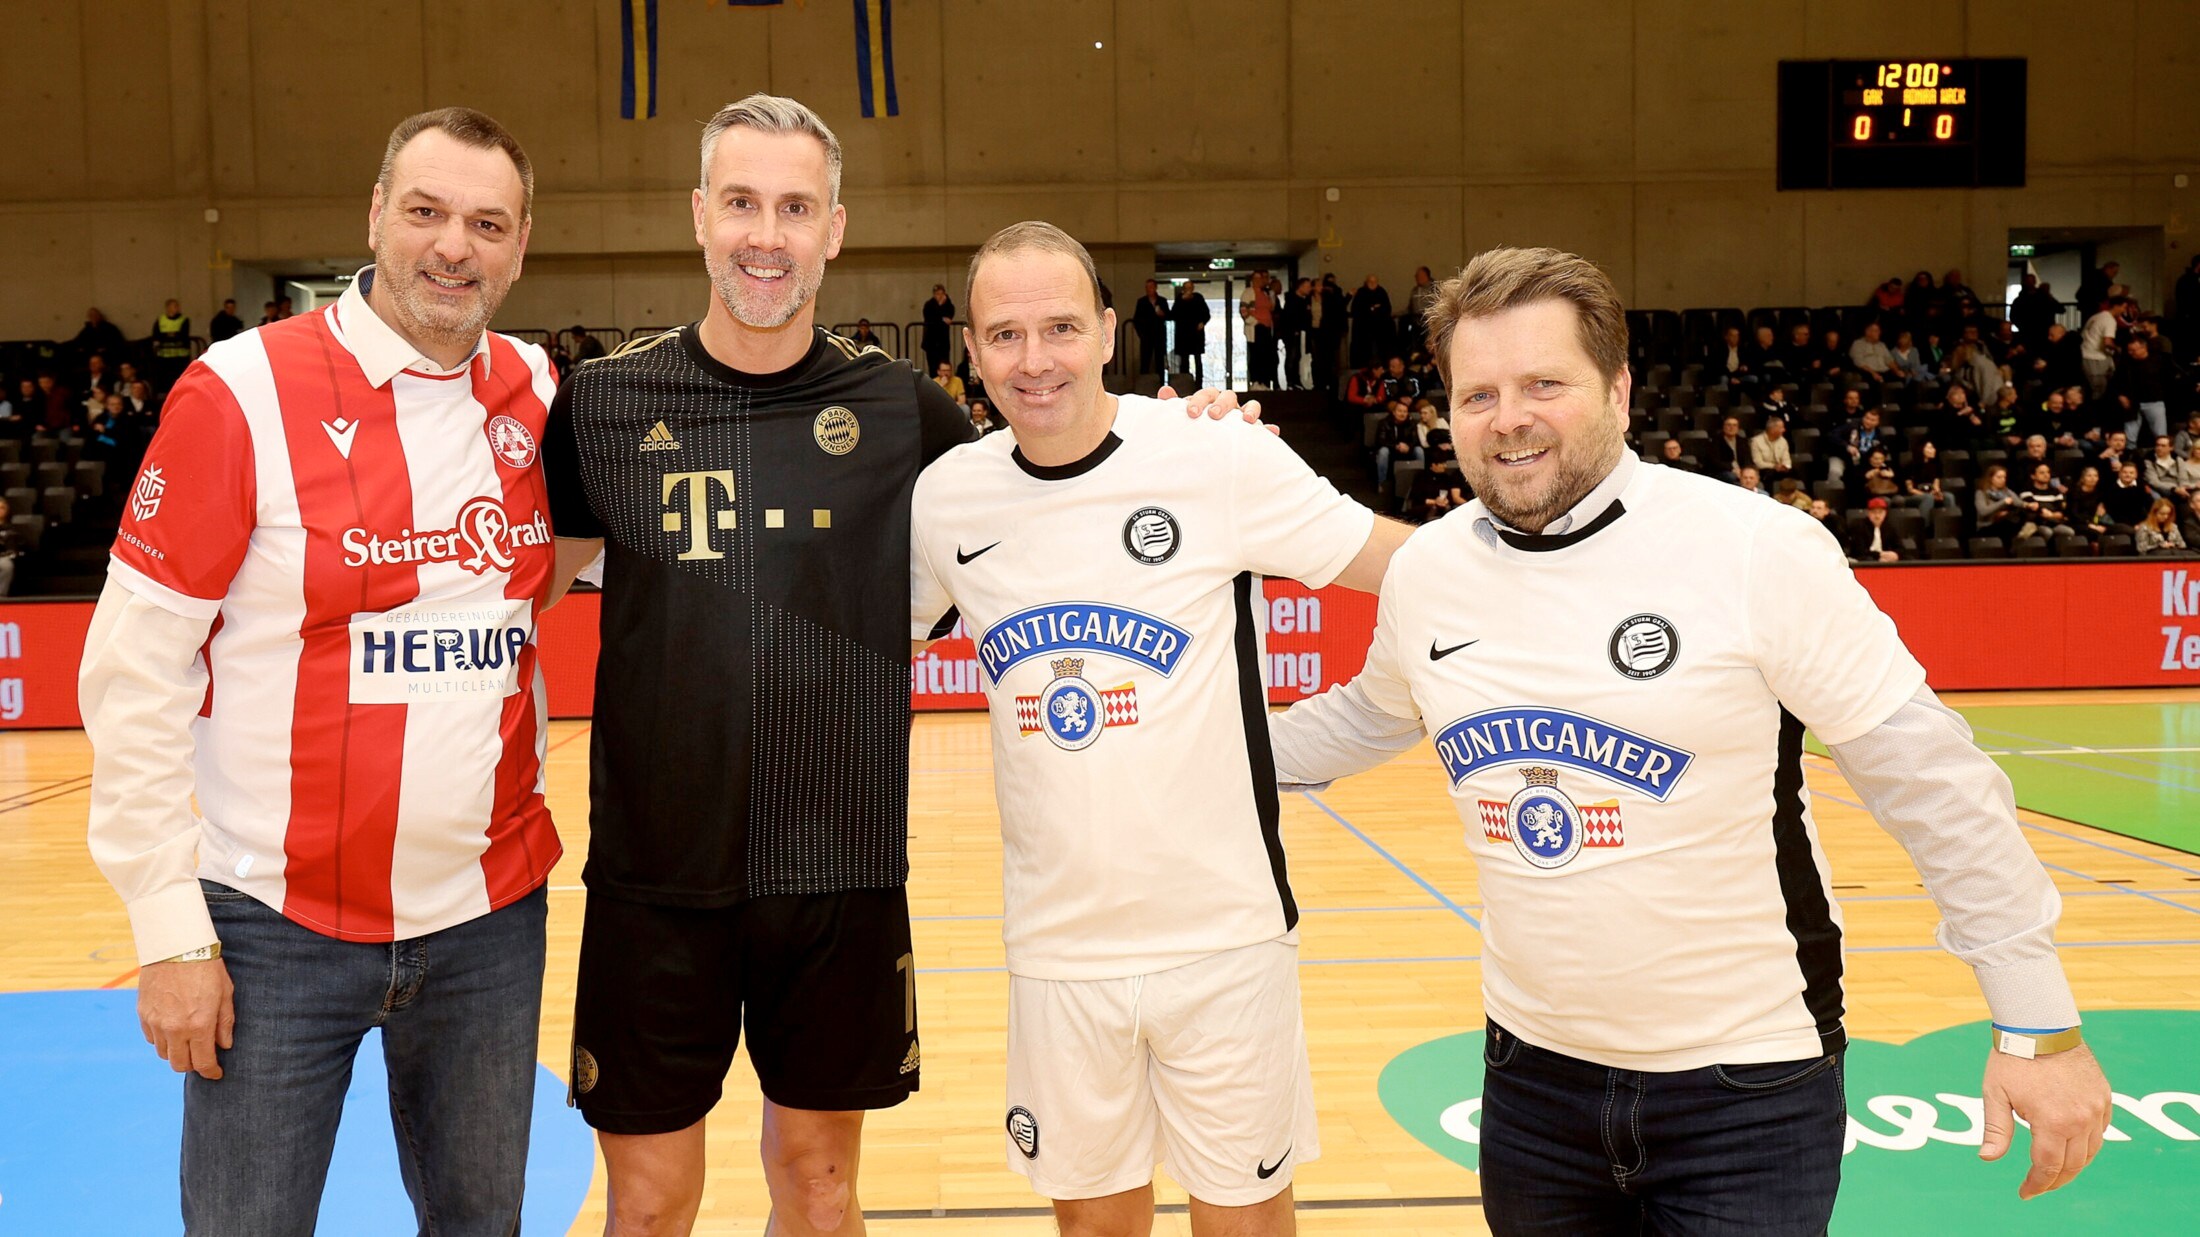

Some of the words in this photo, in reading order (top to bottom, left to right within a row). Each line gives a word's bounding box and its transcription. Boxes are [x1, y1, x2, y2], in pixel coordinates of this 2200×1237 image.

[1854, 115, 1871, 140] 0
[1936, 114, 1953, 139] 0
[818, 415, 828, 427] FC
[827, 410, 856, 429] BAYERN
[639, 440, 681, 451] adidas
[662, 469, 736, 561] T
[1630, 616, 1651, 624] STURM
[1652, 618, 1669, 630] GRAZ
[980, 610, 1178, 677] PUNTIGAMER
[408, 680, 505, 694] MULTICLEAN
[1437, 717, 1673, 788] PUNTIGAMER
